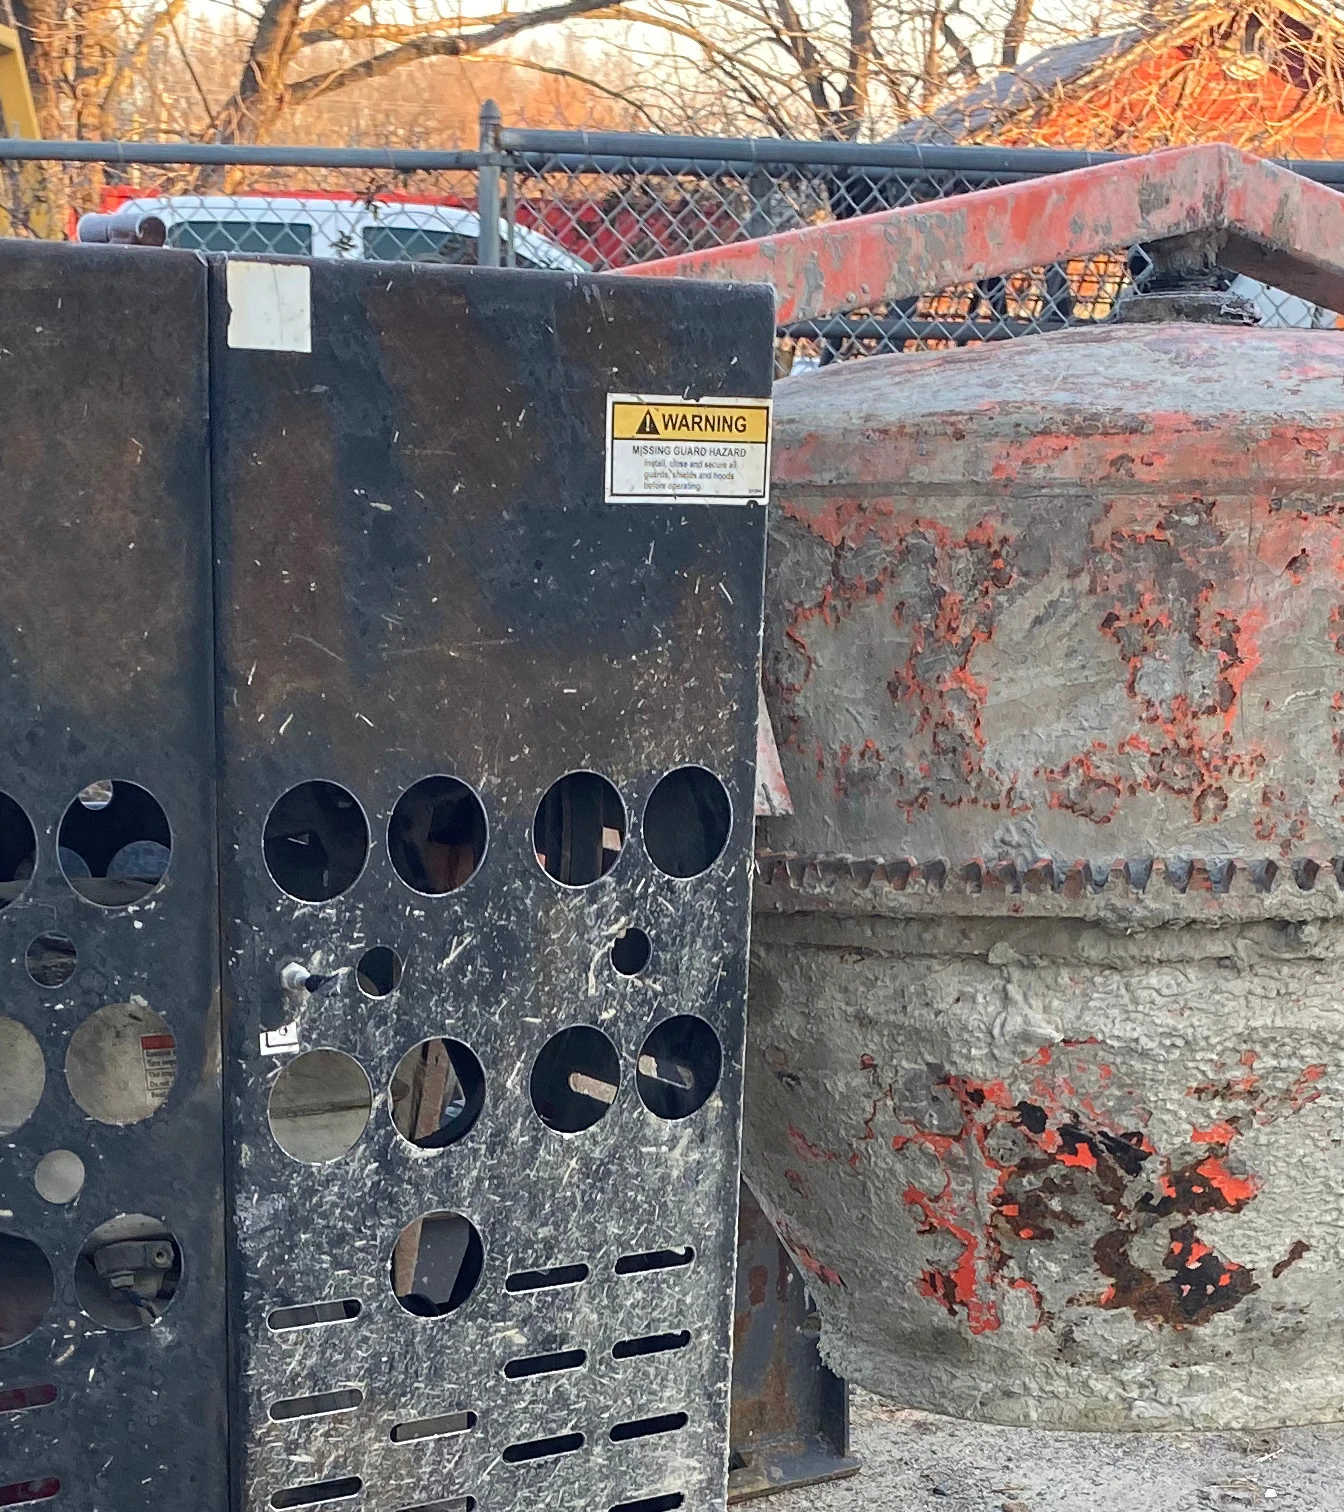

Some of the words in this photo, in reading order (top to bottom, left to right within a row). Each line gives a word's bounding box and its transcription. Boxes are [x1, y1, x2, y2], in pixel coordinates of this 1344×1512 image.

[662, 413, 747, 433] WARNING
[632, 445, 671, 456] MISSING
[674, 446, 707, 456] GUARD
[709, 447, 747, 457] HAZARD
[669, 459, 688, 468] close
[690, 460, 703, 468] and
[705, 461, 727, 469] secure
[729, 460, 737, 469] all
[672, 471, 697, 479] shields
[714, 472, 735, 480] hoods
[644, 481, 666, 490] before
